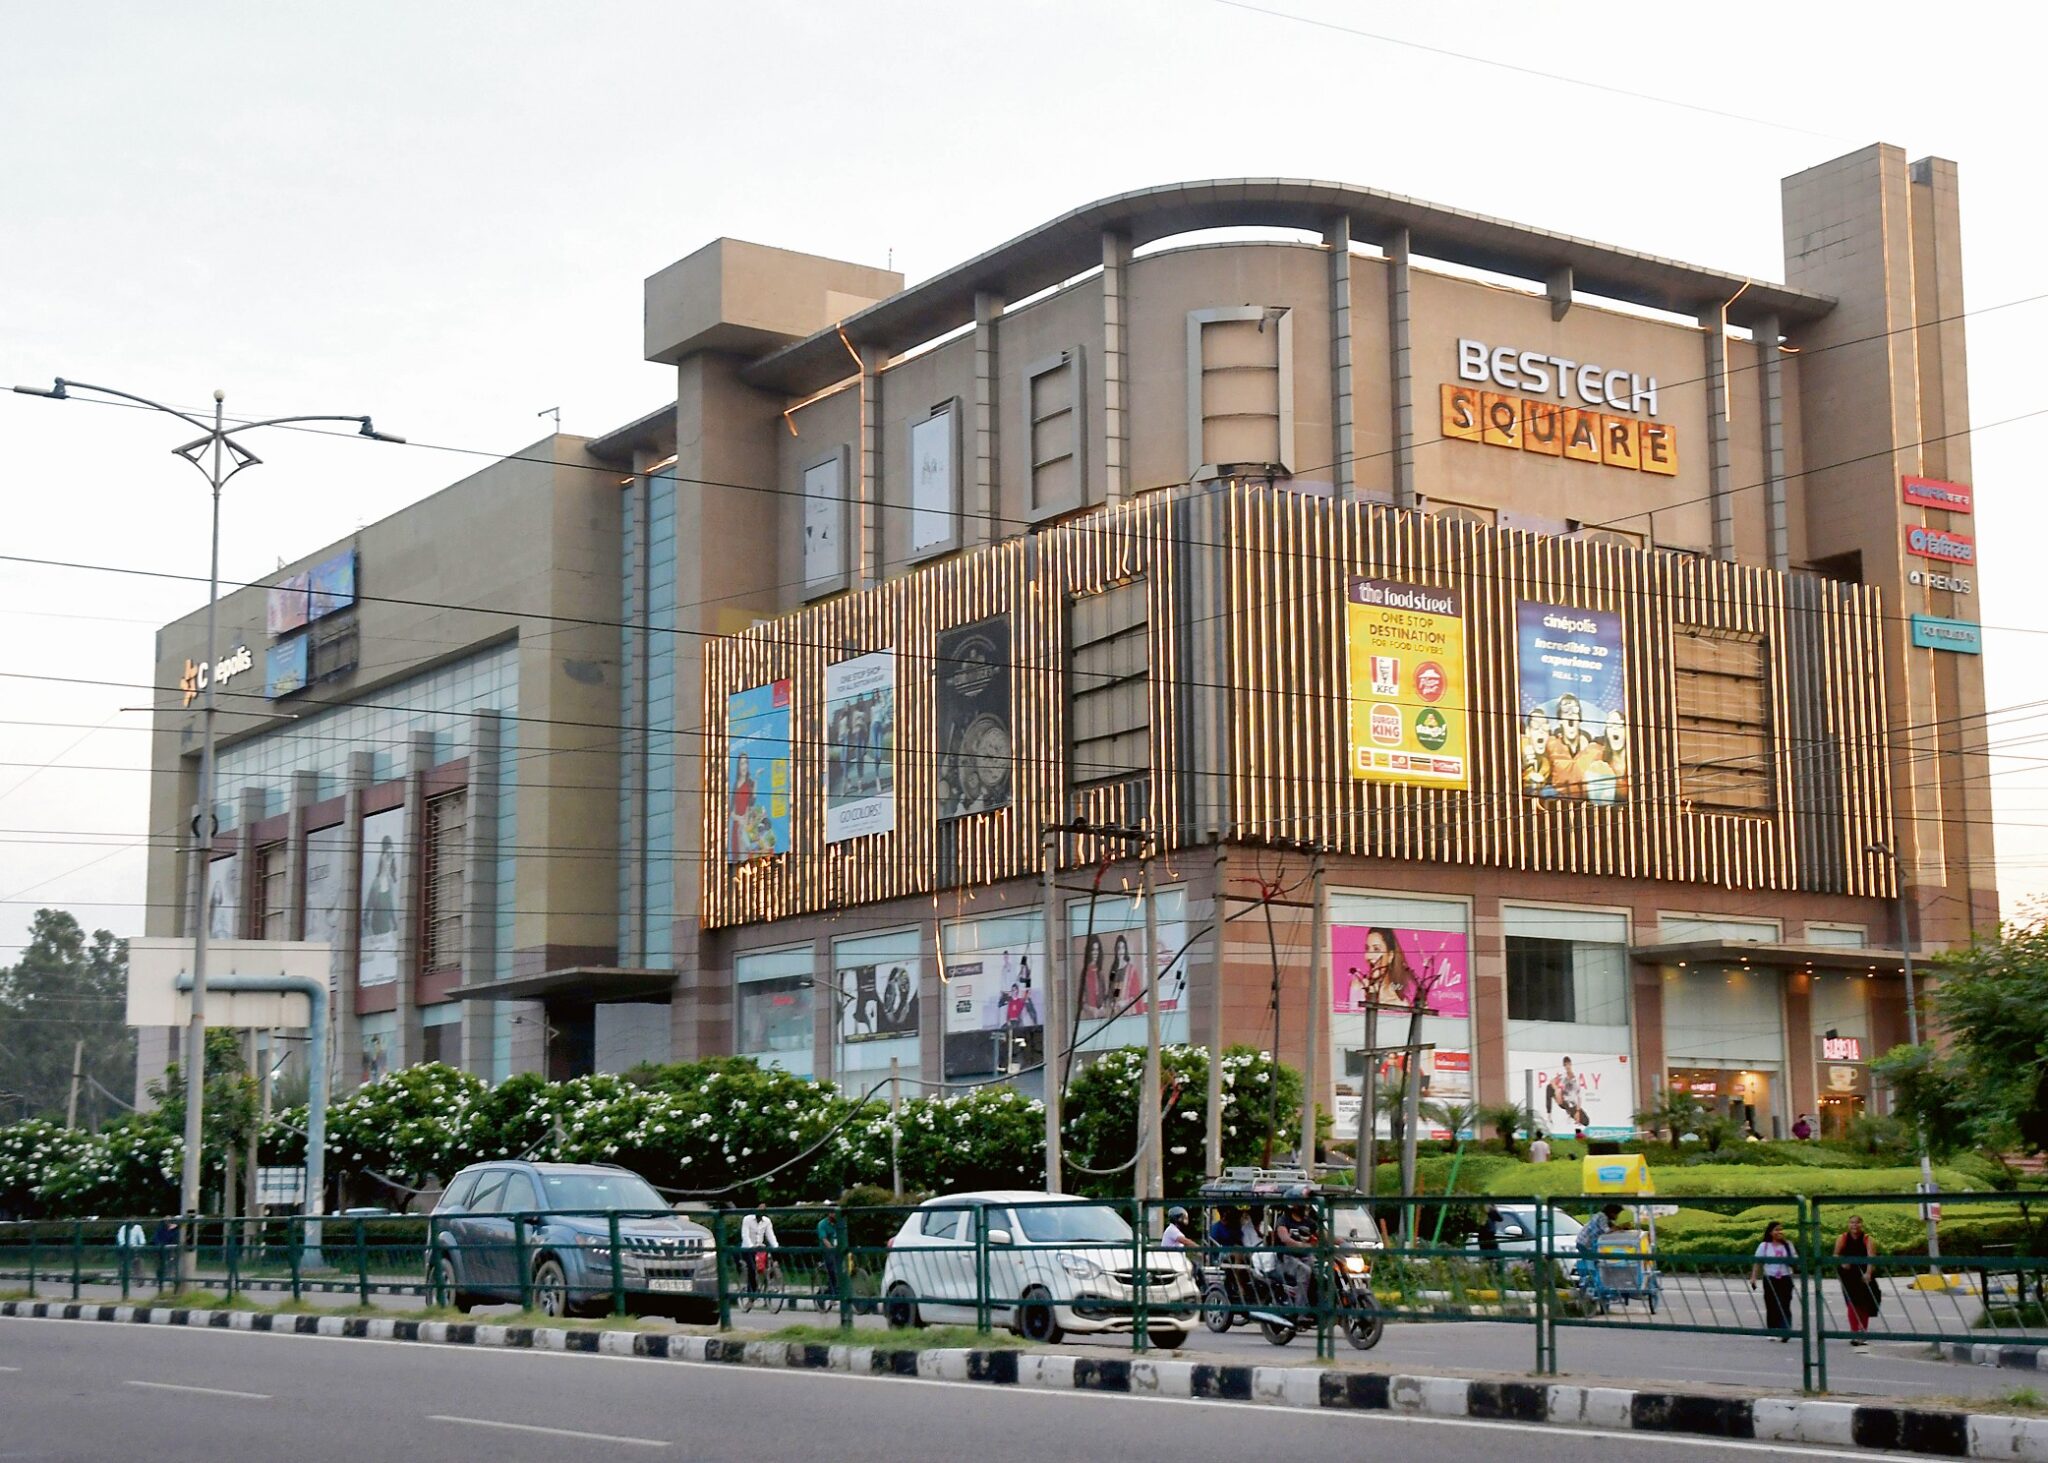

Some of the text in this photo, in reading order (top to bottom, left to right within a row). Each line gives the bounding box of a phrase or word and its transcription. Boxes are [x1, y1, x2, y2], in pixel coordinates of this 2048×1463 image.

[1457, 337, 1657, 416] BESTECH
[1452, 394, 1669, 464] SQUARE
[1919, 572, 1971, 594] TRENDS
[1358, 582, 1383, 604] the
[1380, 612, 1434, 629] ONE STOP
[1369, 623, 1446, 644] DESTINATION
[1371, 637, 1444, 655] FOR FOOD LOVERS
[1540, 654, 1604, 671] experience
[1376, 684, 1395, 695] KFC
[1372, 715, 1399, 725] BURGER
[1371, 724, 1400, 738] KING
